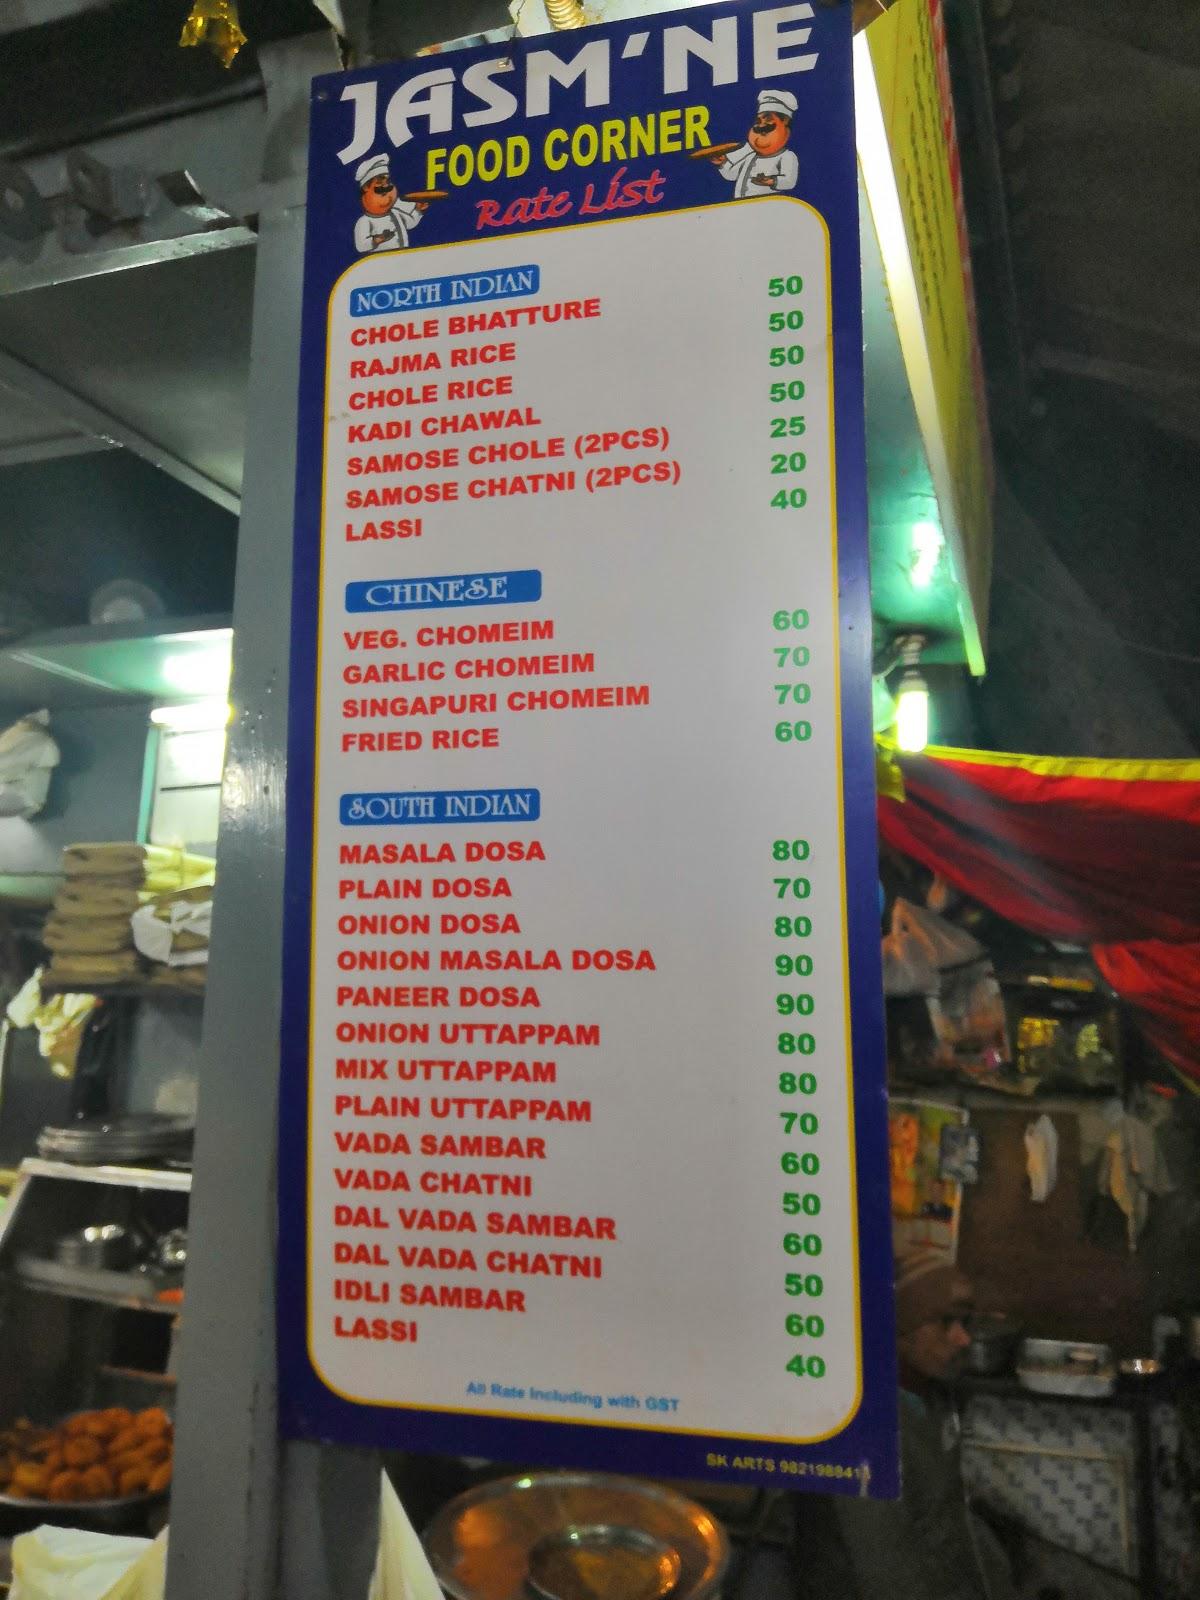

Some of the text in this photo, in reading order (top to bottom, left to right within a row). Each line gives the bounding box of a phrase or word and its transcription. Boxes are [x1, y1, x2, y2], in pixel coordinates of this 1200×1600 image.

[426, 105, 712, 191] FOOD CORNER
[475, 186, 574, 231] Rate
[355, 270, 535, 314] NORTH INDIAN
[768, 275, 804, 298] 50
[349, 296, 601, 348] CHOLE BHATTURE
[768, 309, 805, 334] 50
[348, 341, 517, 380] RAJMA RICE
[768, 344, 805, 368] 50
[348, 374, 512, 412] CHOLE RICE
[768, 379, 806, 404] 50
[347, 406, 542, 444] KADI CHAWAL
[770, 416, 806, 440] 25
[347, 427, 670, 477] SAMOSE CHOLE (2PCS)
[770, 451, 807, 476] 20
[345, 460, 682, 510] SAMOSE CHATNI (2PCS)
[768, 487, 809, 510] 40
[344, 517, 423, 543] LASSI
[365, 575, 508, 607] CHINESE
[771, 608, 809, 632] 60
[343, 618, 555, 652] VEG. CHOMEIM
[342, 652, 595, 686] GARLIC CHOMEIM
[773, 645, 811, 668] 70
[342, 684, 650, 719] SINGAPURI CHOMEIM
[774, 682, 811, 705] 70
[341, 727, 499, 753] FRIED RICE
[774, 720, 812, 744] 60
[348, 793, 532, 821] SOUTH INDIAN
[339, 840, 545, 865] MASALA DOSA
[771, 839, 810, 863] 80
[338, 875, 512, 901] PLAIN DOSA
[772, 875, 812, 901] 70
[337, 912, 521, 936] ONION DOSA
[774, 915, 813, 940] 80
[337, 948, 656, 972] ONION MASALA DOSA
[774, 953, 814, 977] 90
[336, 985, 542, 1008] PANEER DOSA
[774, 992, 815, 1017] 90
[335, 1021, 601, 1047] ONION UTTAPPAM
[777, 1031, 816, 1056] 80
[335, 1057, 557, 1084] MIX UTTAPPAM
[778, 1072, 817, 1097] 80
[334, 1094, 592, 1122] PLAIN UTTAPPAM
[781, 1111, 820, 1136] 70
[332, 1130, 546, 1160] VADA SAMBAR
[780, 1152, 821, 1177] 60
[333, 1168, 533, 1199] VADA CHATNI
[782, 1191, 821, 1216] 50
[333, 1204, 617, 1242] DAL VADA SAMBAR
[783, 1232, 823, 1257] 60
[332, 1241, 603, 1280] DAL VADA CHATNI
[332, 1279, 526, 1313] IDLI SAMBAR
[784, 1272, 823, 1298] 50
[332, 1314, 417, 1344] LASSI
[785, 1312, 826, 1339] 60
[785, 1354, 826, 1380] 40
[466, 1381, 680, 1412] All Rate Including with GST
